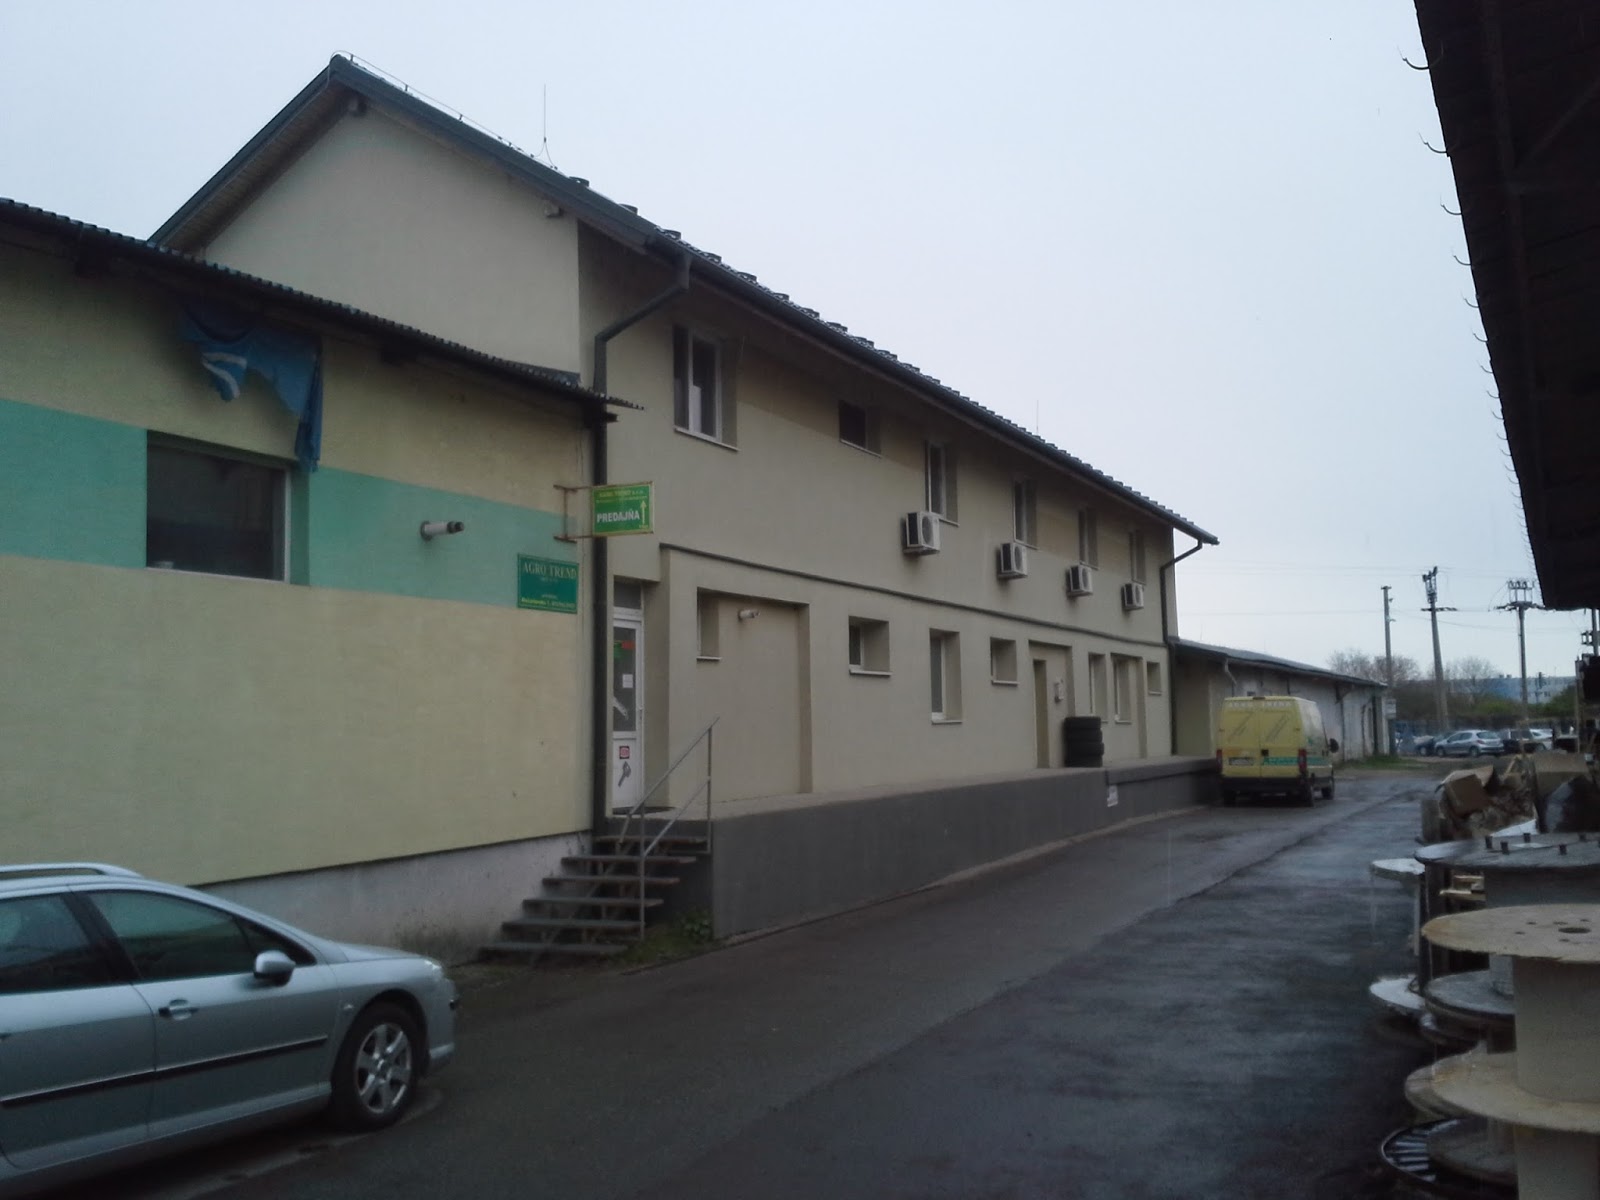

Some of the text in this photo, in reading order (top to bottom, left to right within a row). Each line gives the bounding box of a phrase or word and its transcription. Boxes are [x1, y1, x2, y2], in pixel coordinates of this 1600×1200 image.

[596, 508, 640, 523] PREDAJŇA
[523, 561, 577, 580] AGRO TREND
